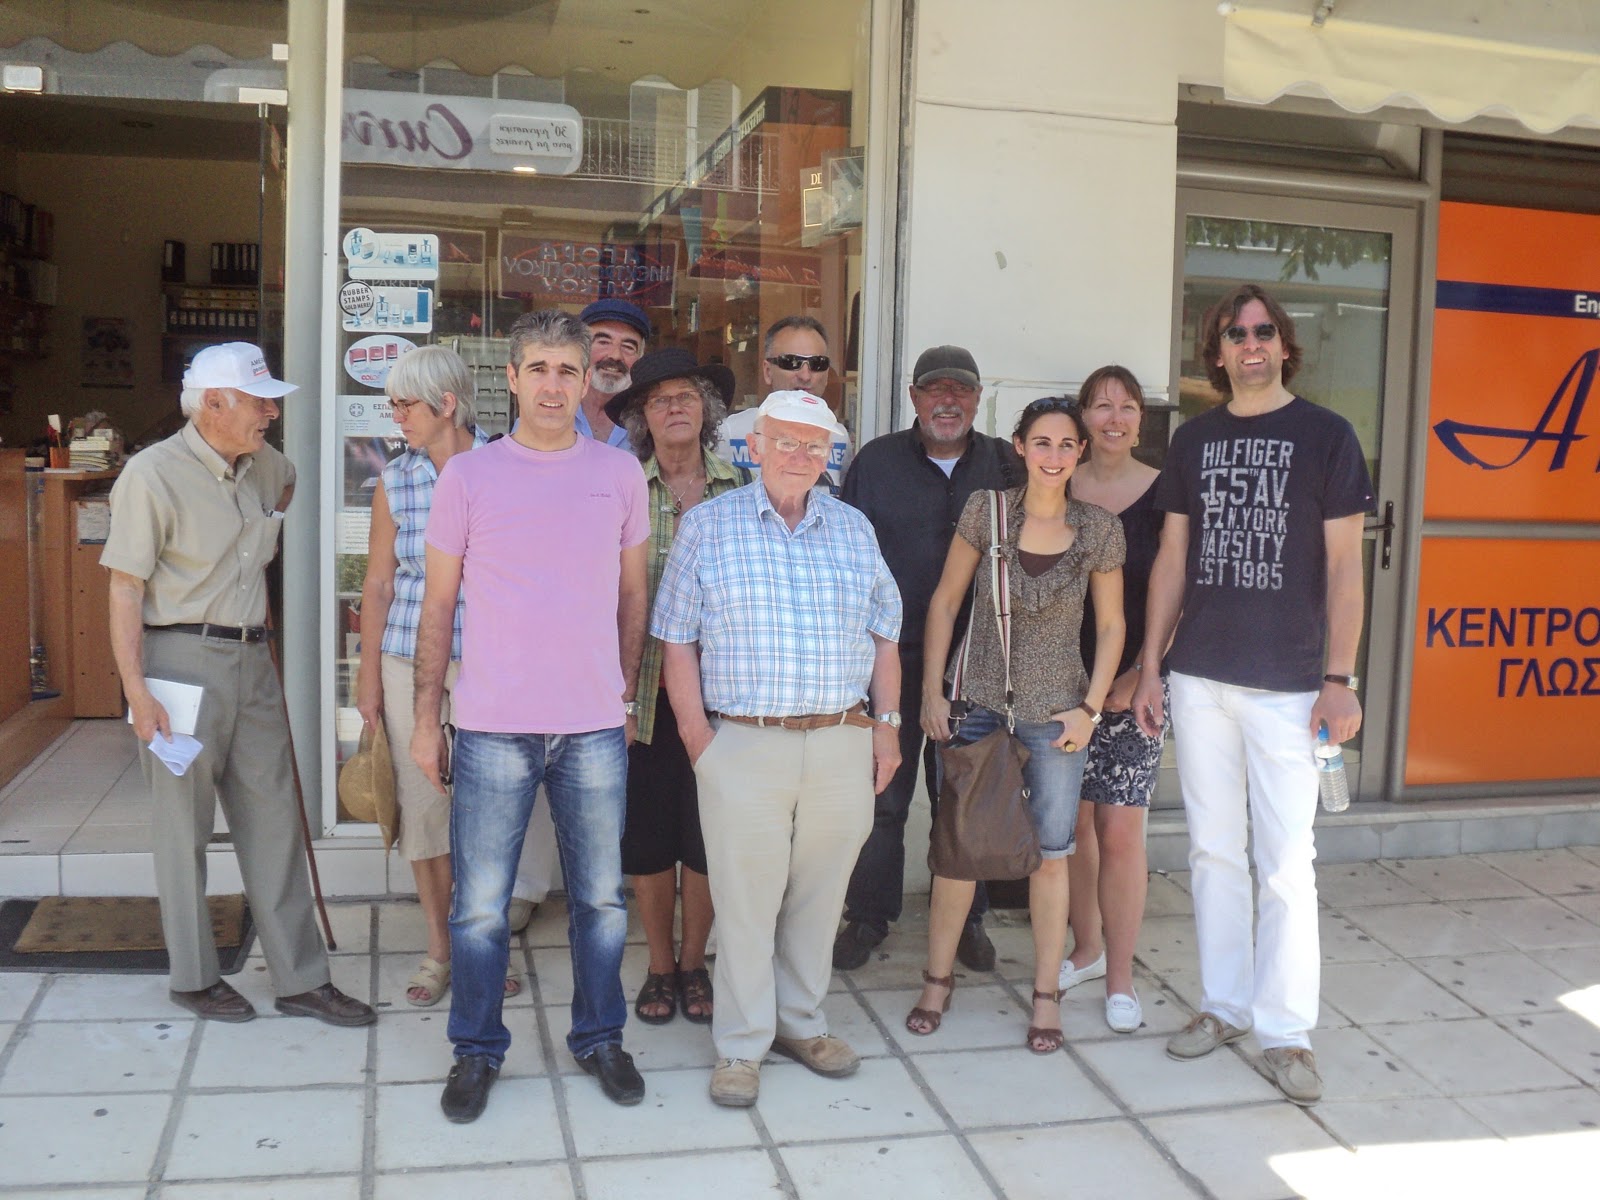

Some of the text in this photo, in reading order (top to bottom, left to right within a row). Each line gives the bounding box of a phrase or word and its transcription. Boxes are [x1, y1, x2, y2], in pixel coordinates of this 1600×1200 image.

[342, 287, 369, 297] RUBBER
[343, 294, 370, 305] STAMPS
[1202, 438, 1294, 469] HILFIGER
[1201, 529, 1286, 562] VARSITY
[1232, 560, 1284, 590] 1985
[1426, 607, 1600, 648] ΚΕΝΤΡΟ
[1497, 657, 1600, 697] ΓΛΩΣ
